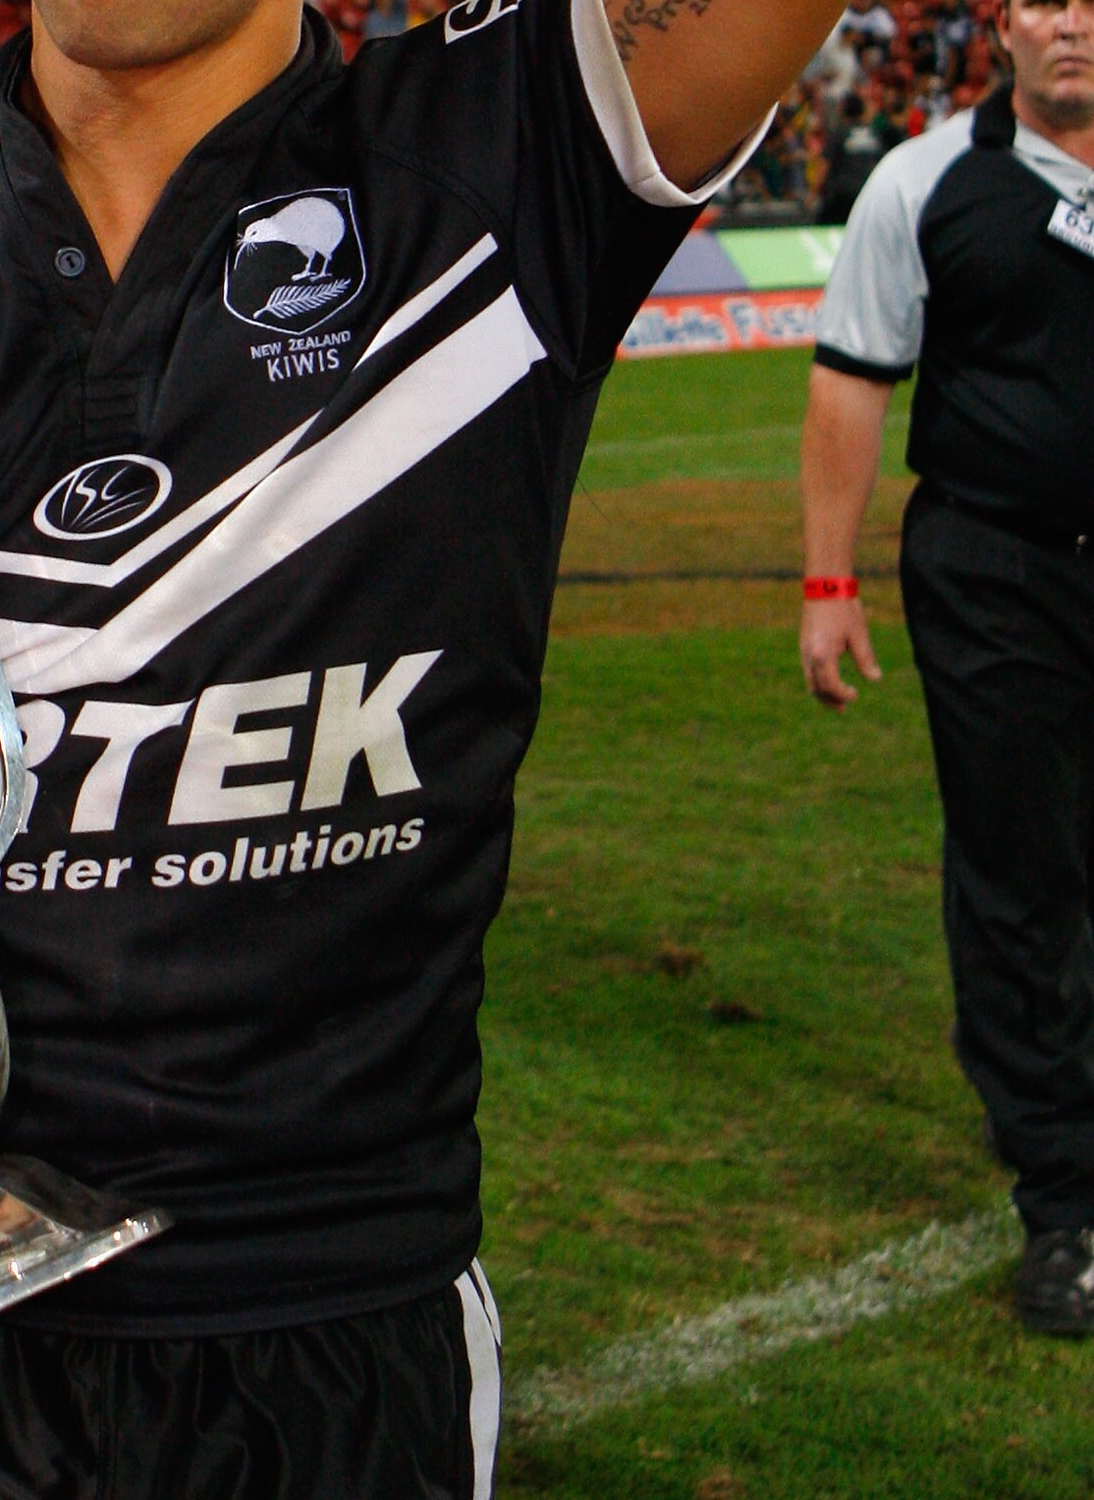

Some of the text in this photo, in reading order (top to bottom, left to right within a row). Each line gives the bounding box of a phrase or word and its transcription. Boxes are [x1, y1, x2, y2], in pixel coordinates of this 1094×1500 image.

[250, 329, 352, 360] NEW ZEALAND
[266, 349, 340, 382] KIWIS
[151, 816, 425, 890] solutions
